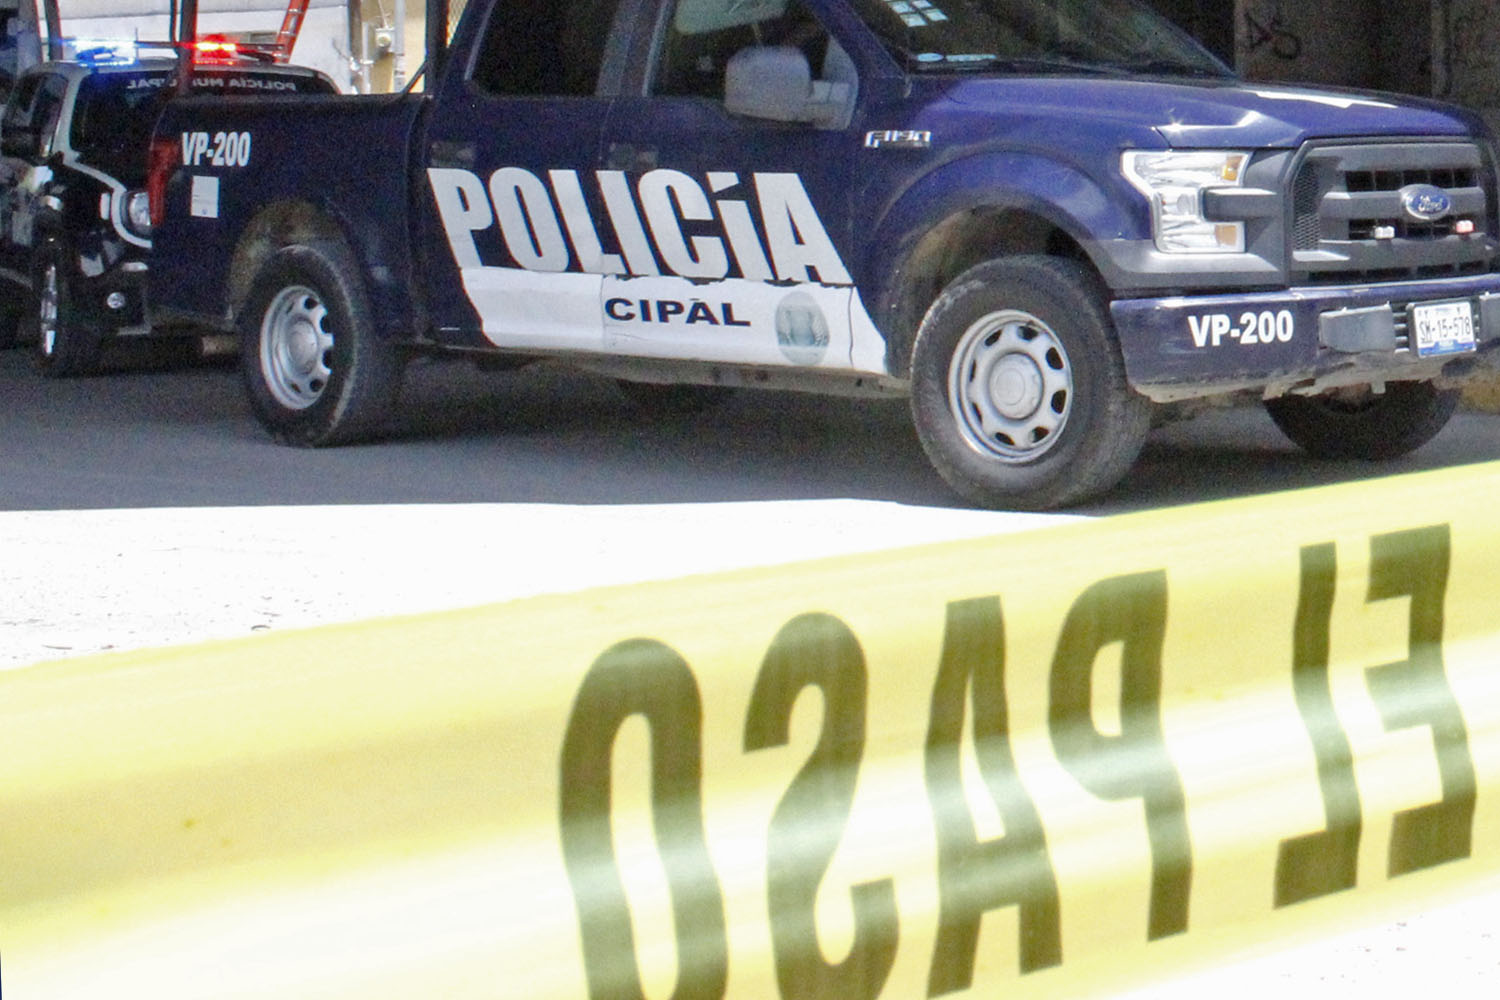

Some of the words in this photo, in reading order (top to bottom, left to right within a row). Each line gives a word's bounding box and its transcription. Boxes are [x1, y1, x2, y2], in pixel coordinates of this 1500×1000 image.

[182, 131, 252, 167] VP-200
[604, 297, 751, 328] CIPAL
[1187, 309, 1294, 348] VP-200
